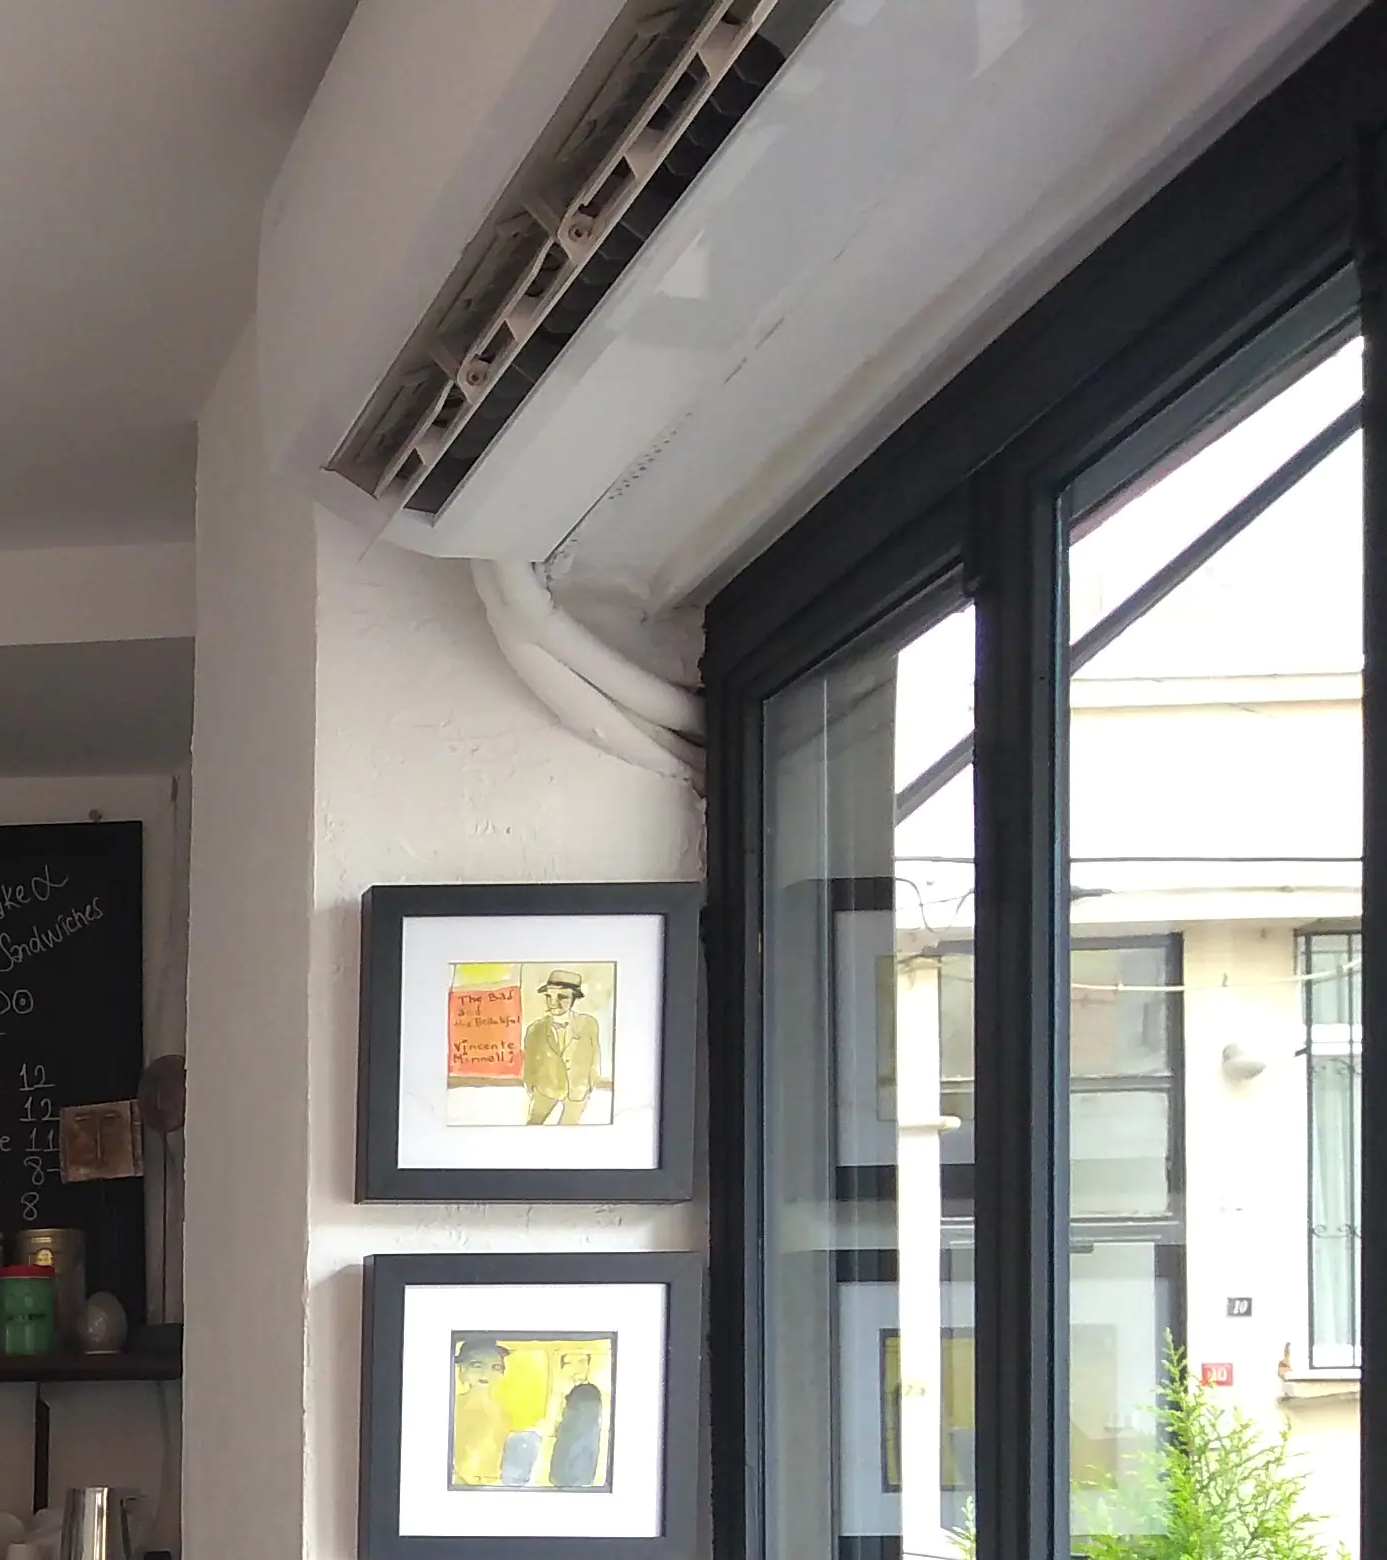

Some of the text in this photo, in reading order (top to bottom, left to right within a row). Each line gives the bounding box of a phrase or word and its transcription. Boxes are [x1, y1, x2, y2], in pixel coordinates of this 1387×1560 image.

[458, 990, 514, 1006] The Bad
[19, 1063, 56, 1092] 12
[19, 1096, 61, 1122] 12
[25, 1127, 60, 1152] 11
[20, 1191, 40, 1221] 8
